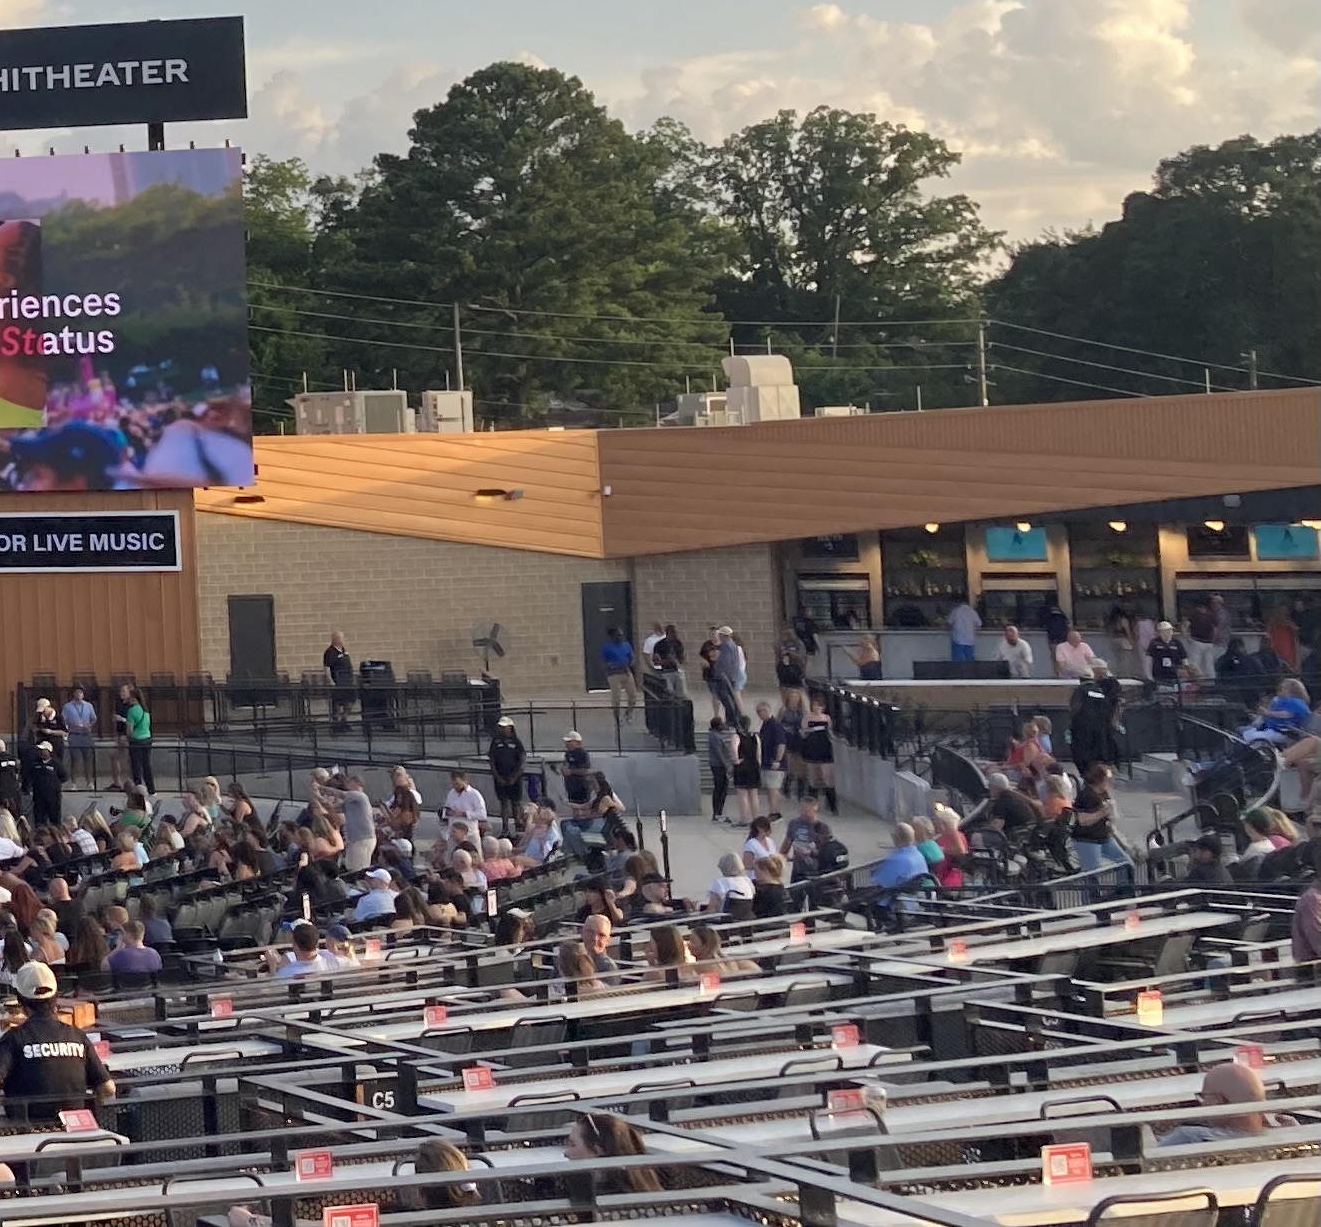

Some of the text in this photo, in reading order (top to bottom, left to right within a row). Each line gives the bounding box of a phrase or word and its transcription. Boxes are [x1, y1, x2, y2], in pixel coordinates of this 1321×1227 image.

[1, 325, 115, 358] Status
[33, 533, 84, 553] LIVE
[89, 532, 165, 552] MUSIC
[22, 1042, 85, 1059] SECURITY
[372, 1090, 395, 1110] C5
